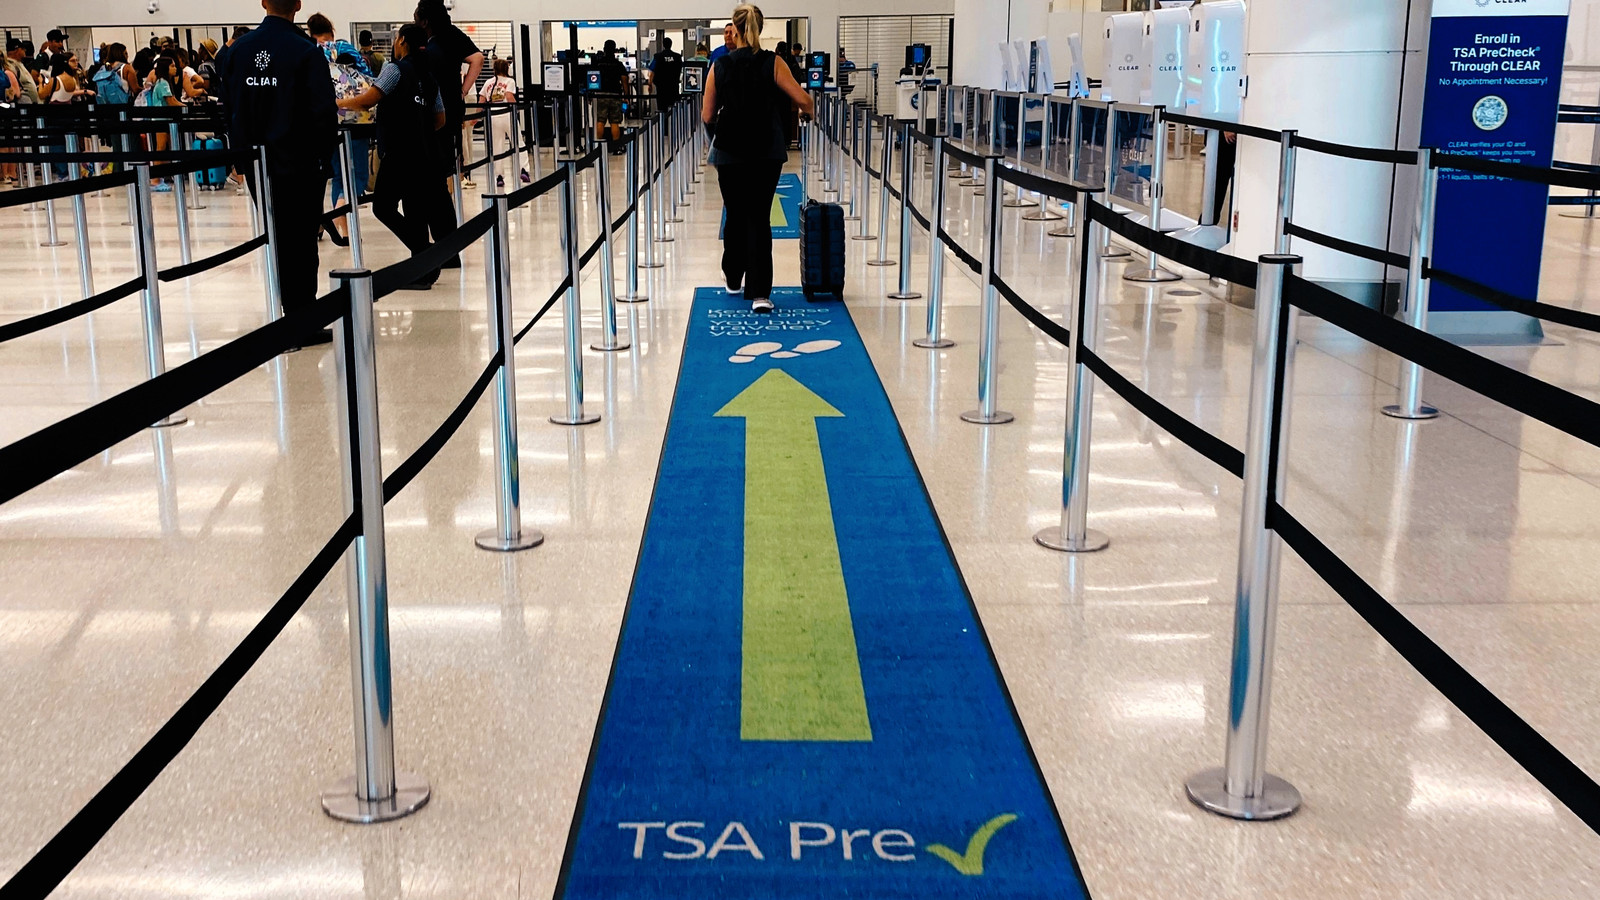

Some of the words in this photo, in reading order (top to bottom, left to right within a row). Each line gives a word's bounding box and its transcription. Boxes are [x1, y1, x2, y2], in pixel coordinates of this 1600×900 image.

[1474, 33, 1508, 44] Enroll
[1509, 33, 1521, 44] in
[1453, 47, 1477, 58] TSA
[1450, 61, 1498, 73] Through
[1501, 60, 1540, 71] CLEAR
[246, 76, 278, 87] CLEAR
[1439, 78, 1451, 86] No
[1452, 77, 1502, 87] Appointment
[1503, 76, 1548, 86] Necessary!
[618, 821, 765, 861] TSA
[789, 821, 917, 862] Pre
